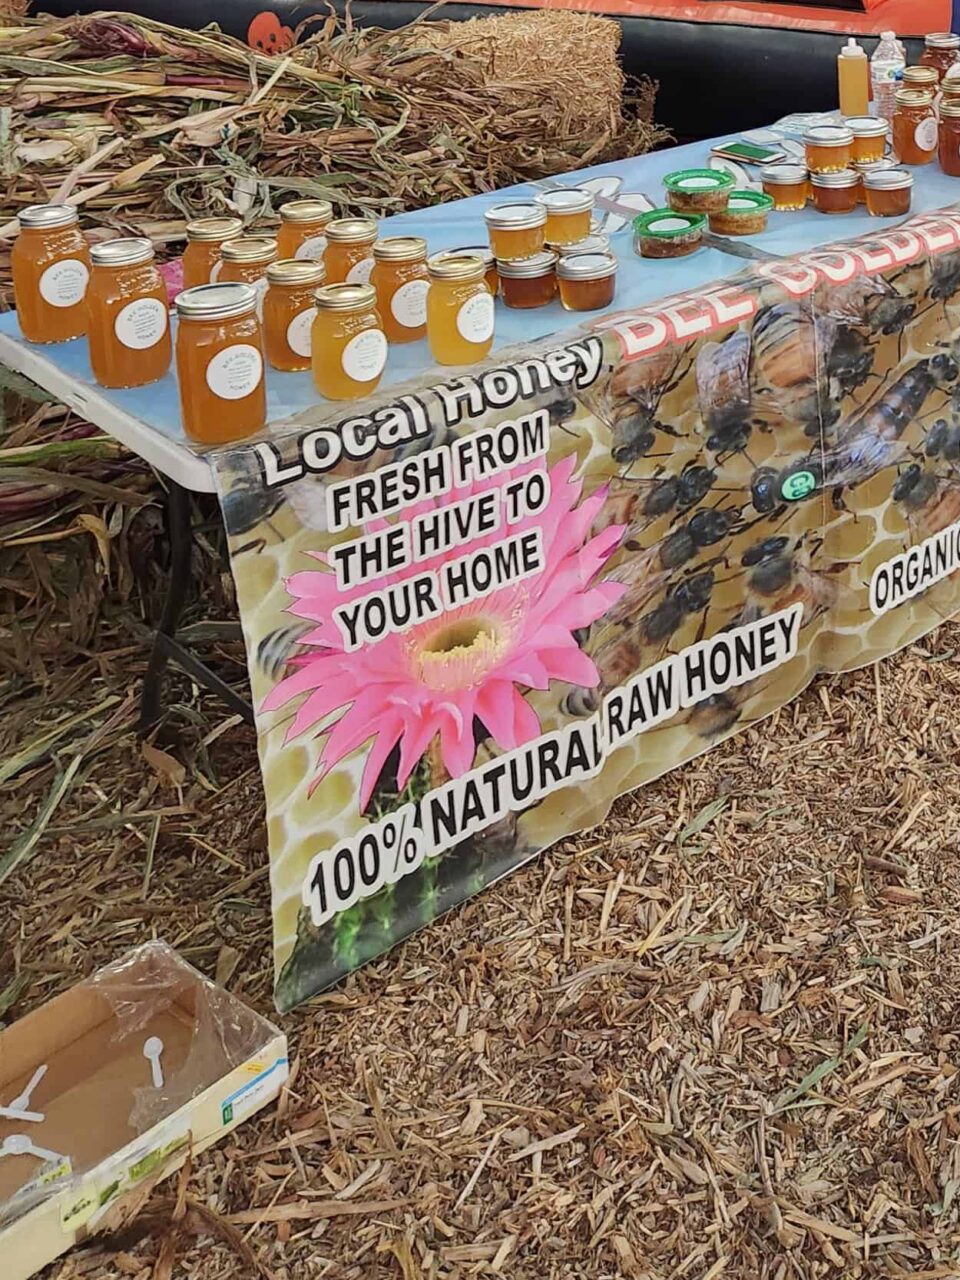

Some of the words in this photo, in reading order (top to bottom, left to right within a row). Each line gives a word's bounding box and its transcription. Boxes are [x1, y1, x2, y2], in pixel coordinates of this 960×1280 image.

[256, 395, 430, 488] Local
[435, 336, 603, 425] Honey
[332, 451, 447, 526] FRESH
[460, 413, 545, 481] FROM
[334, 530, 407, 585] THE
[417, 495, 496, 556] HIVE
[507, 474, 546, 518] TO
[338, 577, 438, 646] YOUR
[446, 533, 540, 605] HOME
[310, 819, 418, 914] 100%
[431, 721, 602, 845] NATURAL
[607, 676, 673, 742] RAW
[685, 613, 801, 699] HONEY
